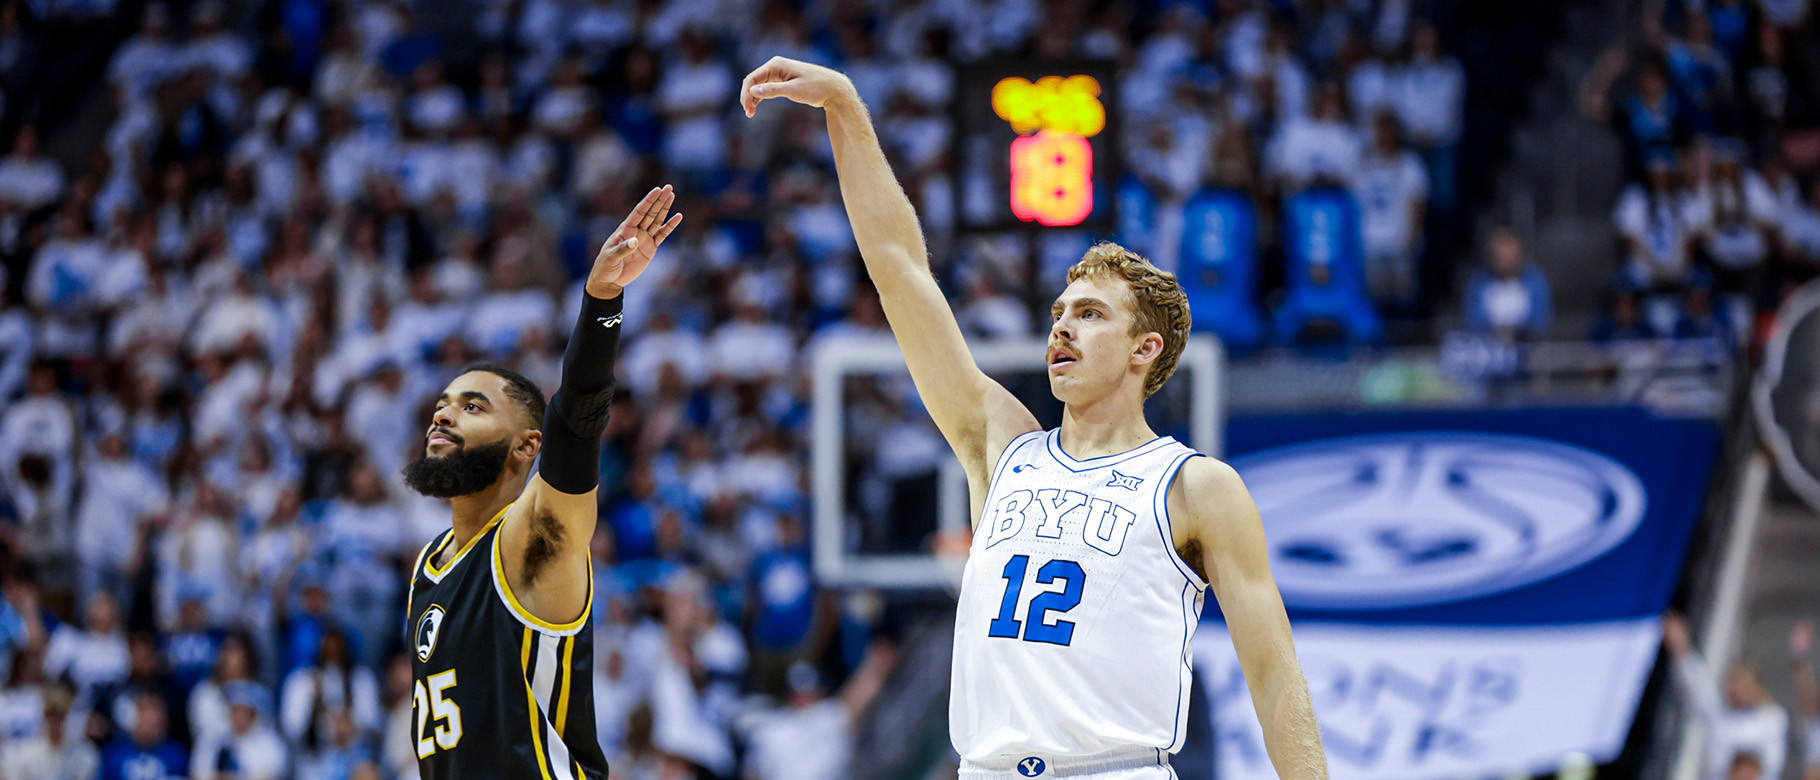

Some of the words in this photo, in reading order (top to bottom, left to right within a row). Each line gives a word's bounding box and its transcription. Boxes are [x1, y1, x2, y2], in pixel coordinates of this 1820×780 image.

[985, 488, 1137, 557] BYU
[987, 554, 1087, 647] 12
[412, 668, 464, 760] 25
[1020, 758, 1041, 775] Y
